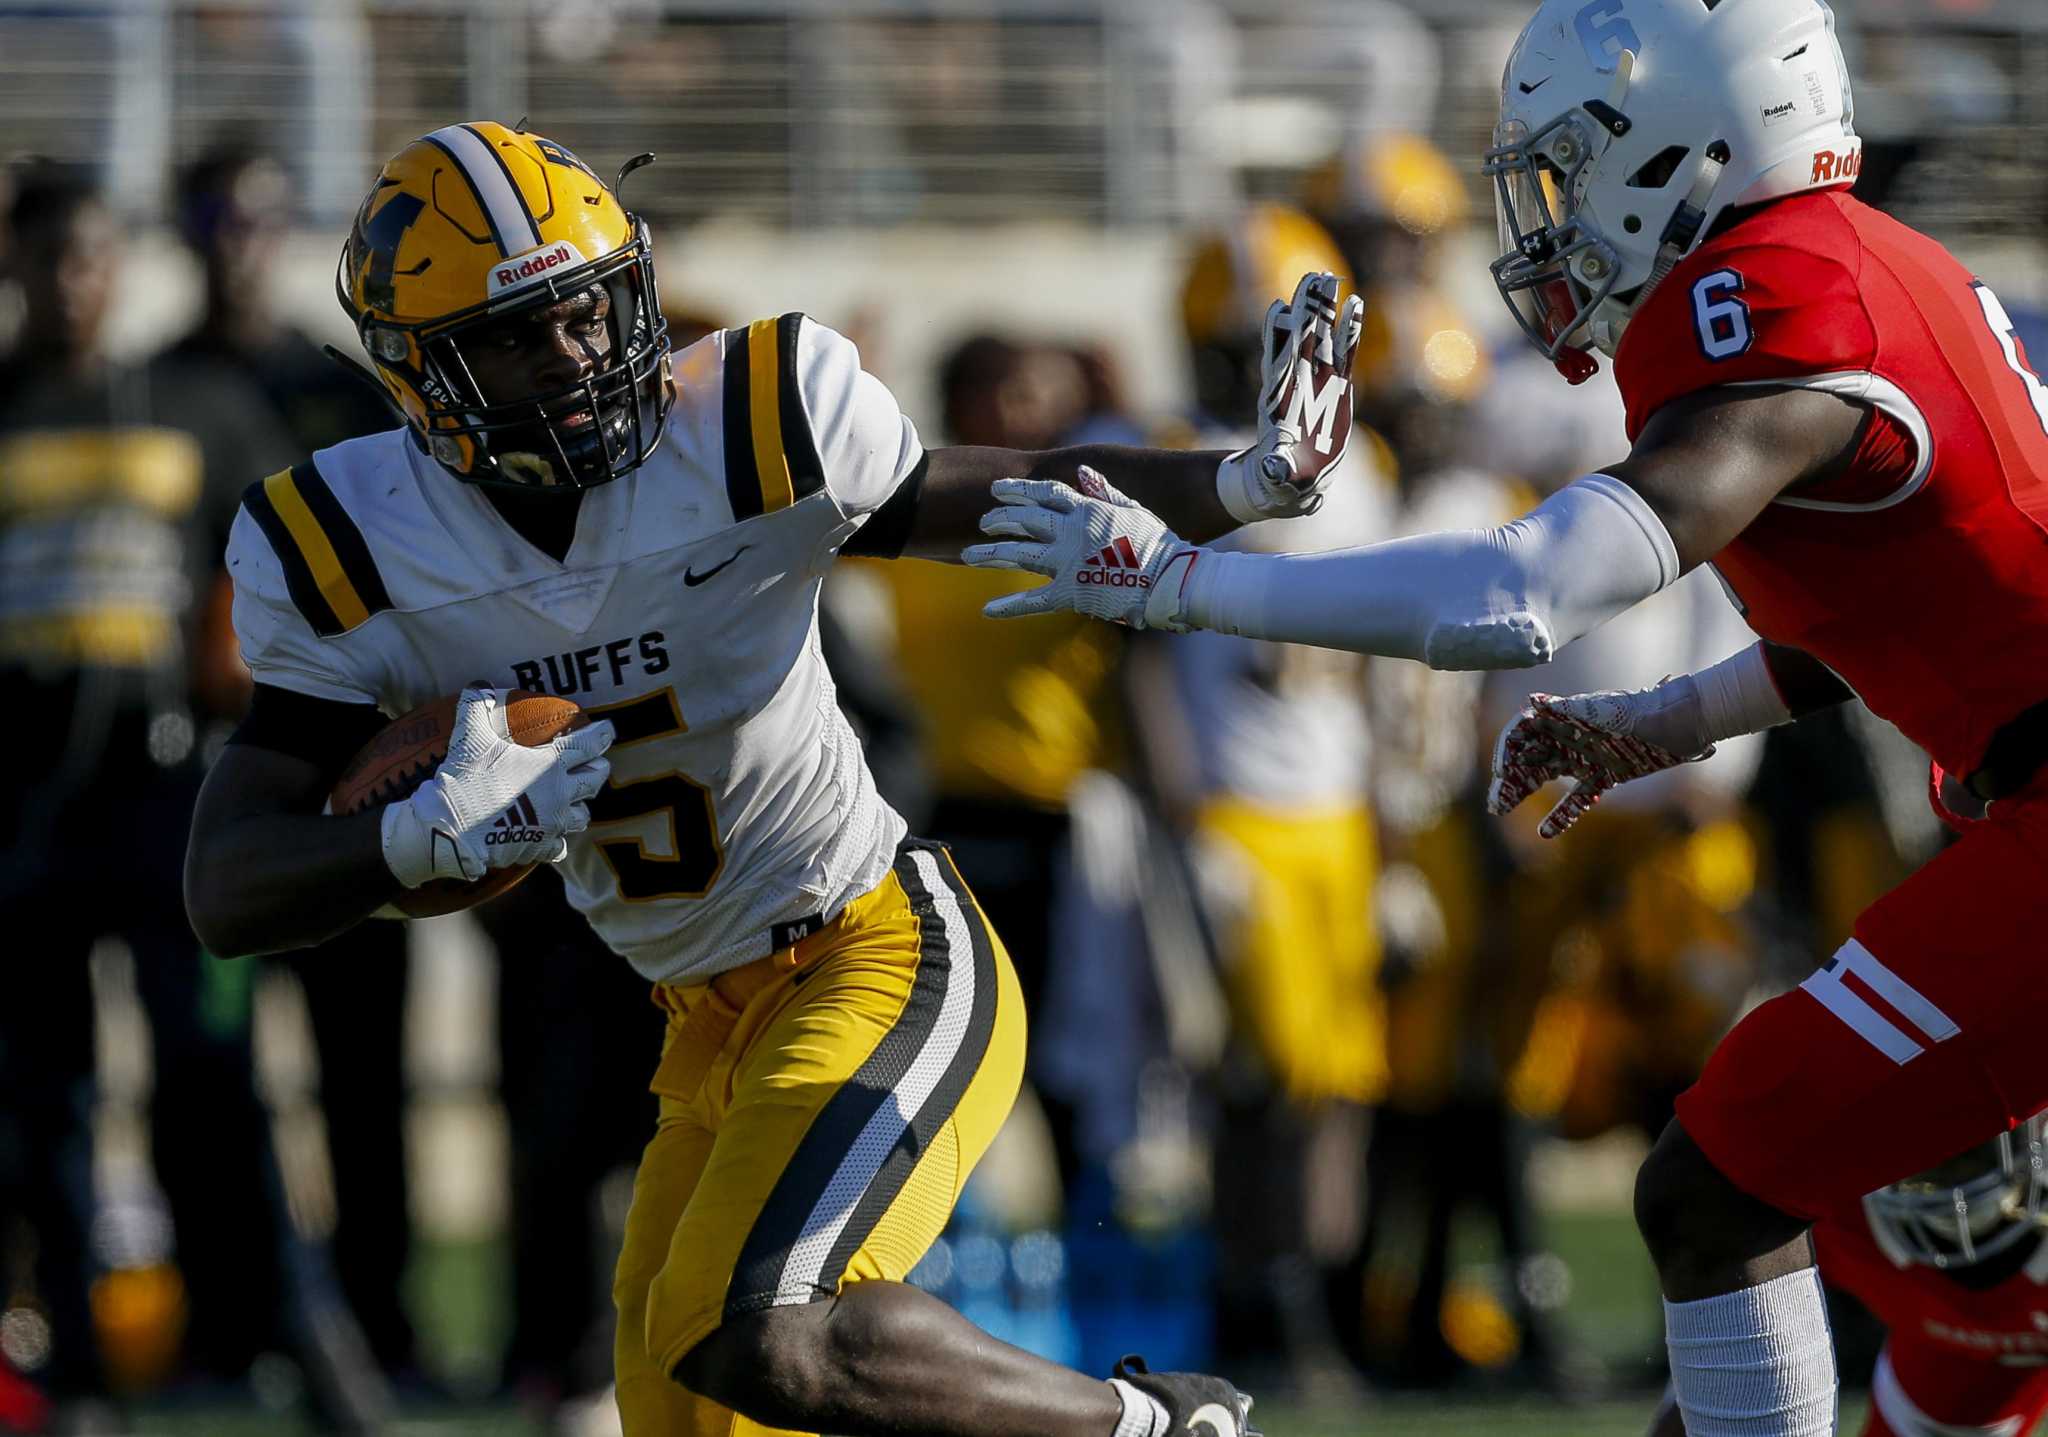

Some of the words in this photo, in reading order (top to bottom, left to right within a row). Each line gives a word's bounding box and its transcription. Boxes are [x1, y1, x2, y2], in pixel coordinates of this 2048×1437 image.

[1573, 0, 1641, 75] 6
[495, 246, 571, 287] Riddell
[1690, 266, 1754, 362] 6
[1278, 357, 1348, 455] M
[1076, 566, 1151, 588] adidas
[510, 631, 670, 696] BUFFS
[586, 685, 725, 903] 5
[485, 826, 545, 846] adidas
[788, 923, 808, 943] M
